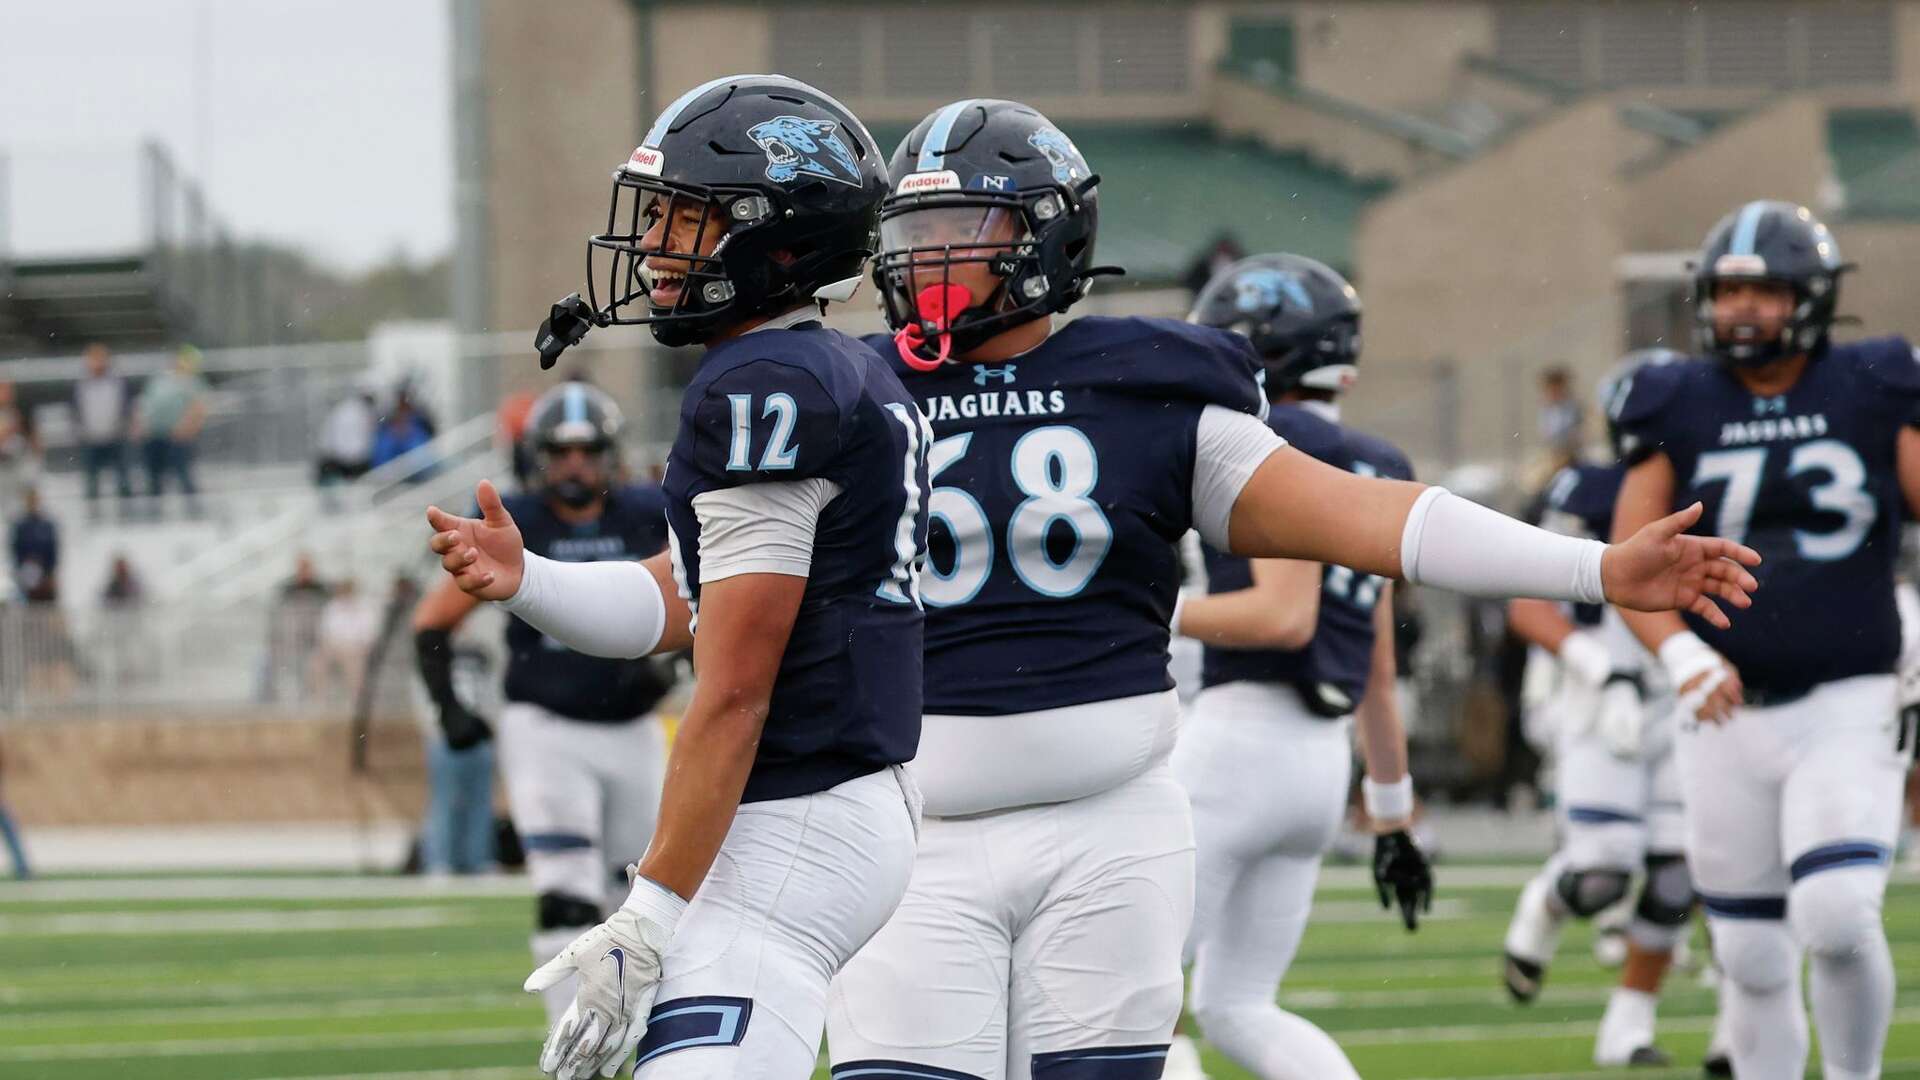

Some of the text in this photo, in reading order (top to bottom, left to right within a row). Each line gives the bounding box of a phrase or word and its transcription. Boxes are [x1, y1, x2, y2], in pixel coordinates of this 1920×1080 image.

[726, 392, 800, 471] 12
[926, 390, 1065, 421] JAGUARS
[920, 425, 1114, 608] 68
[1691, 440, 1877, 562] 73
